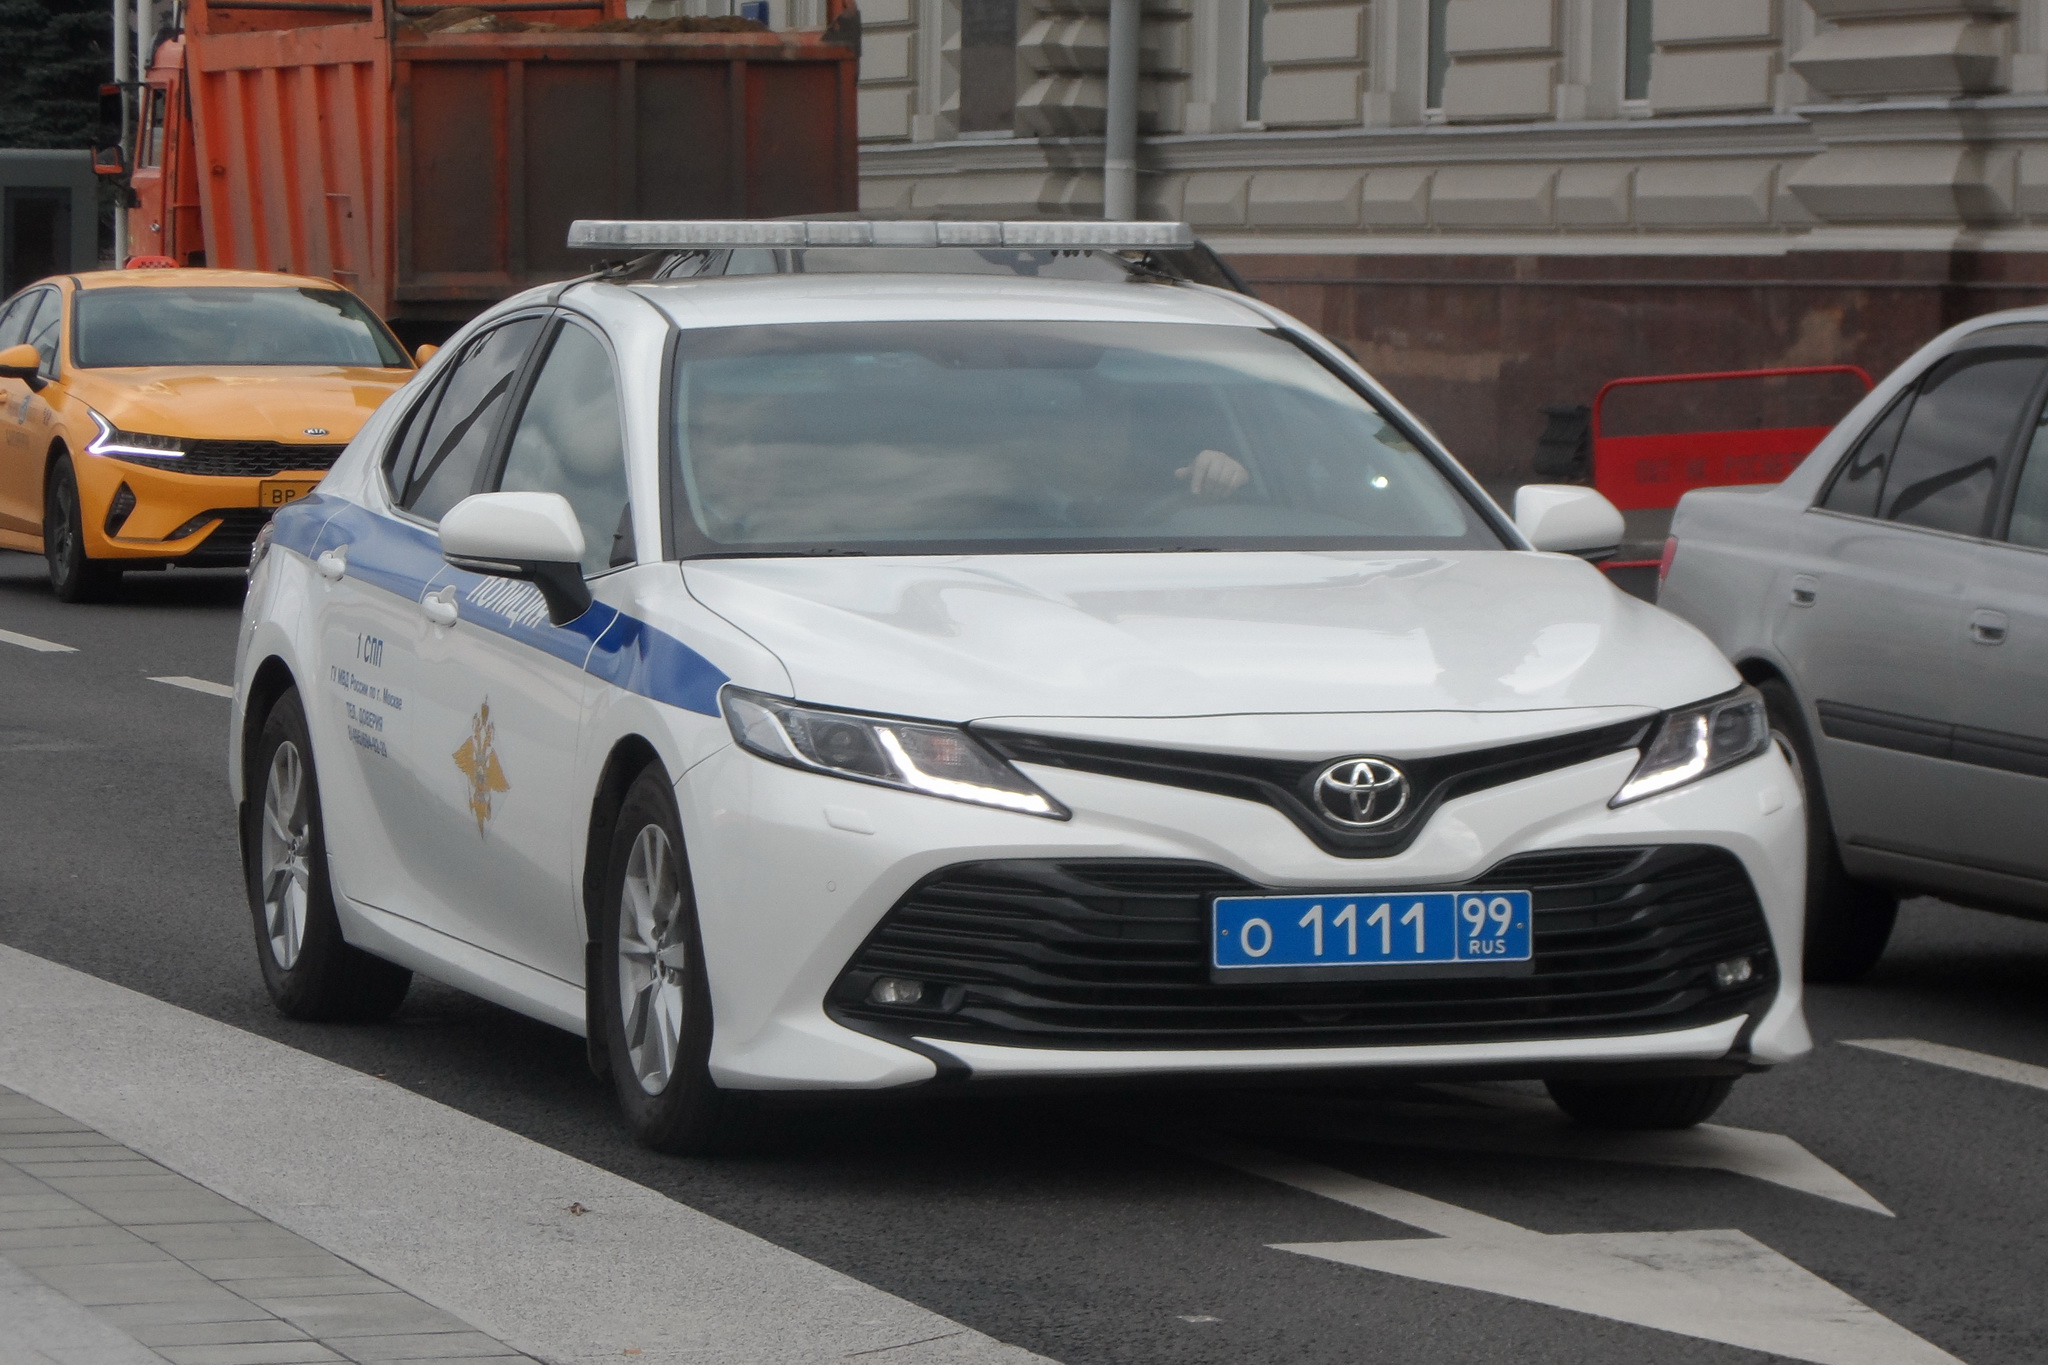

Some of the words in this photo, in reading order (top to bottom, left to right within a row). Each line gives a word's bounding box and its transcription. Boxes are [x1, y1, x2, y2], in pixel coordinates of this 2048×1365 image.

[363, 634, 384, 667] СПП
[1298, 902, 1424, 956] 1111
[1462, 897, 1512, 937] 99
[1469, 939, 1506, 955] RUS
